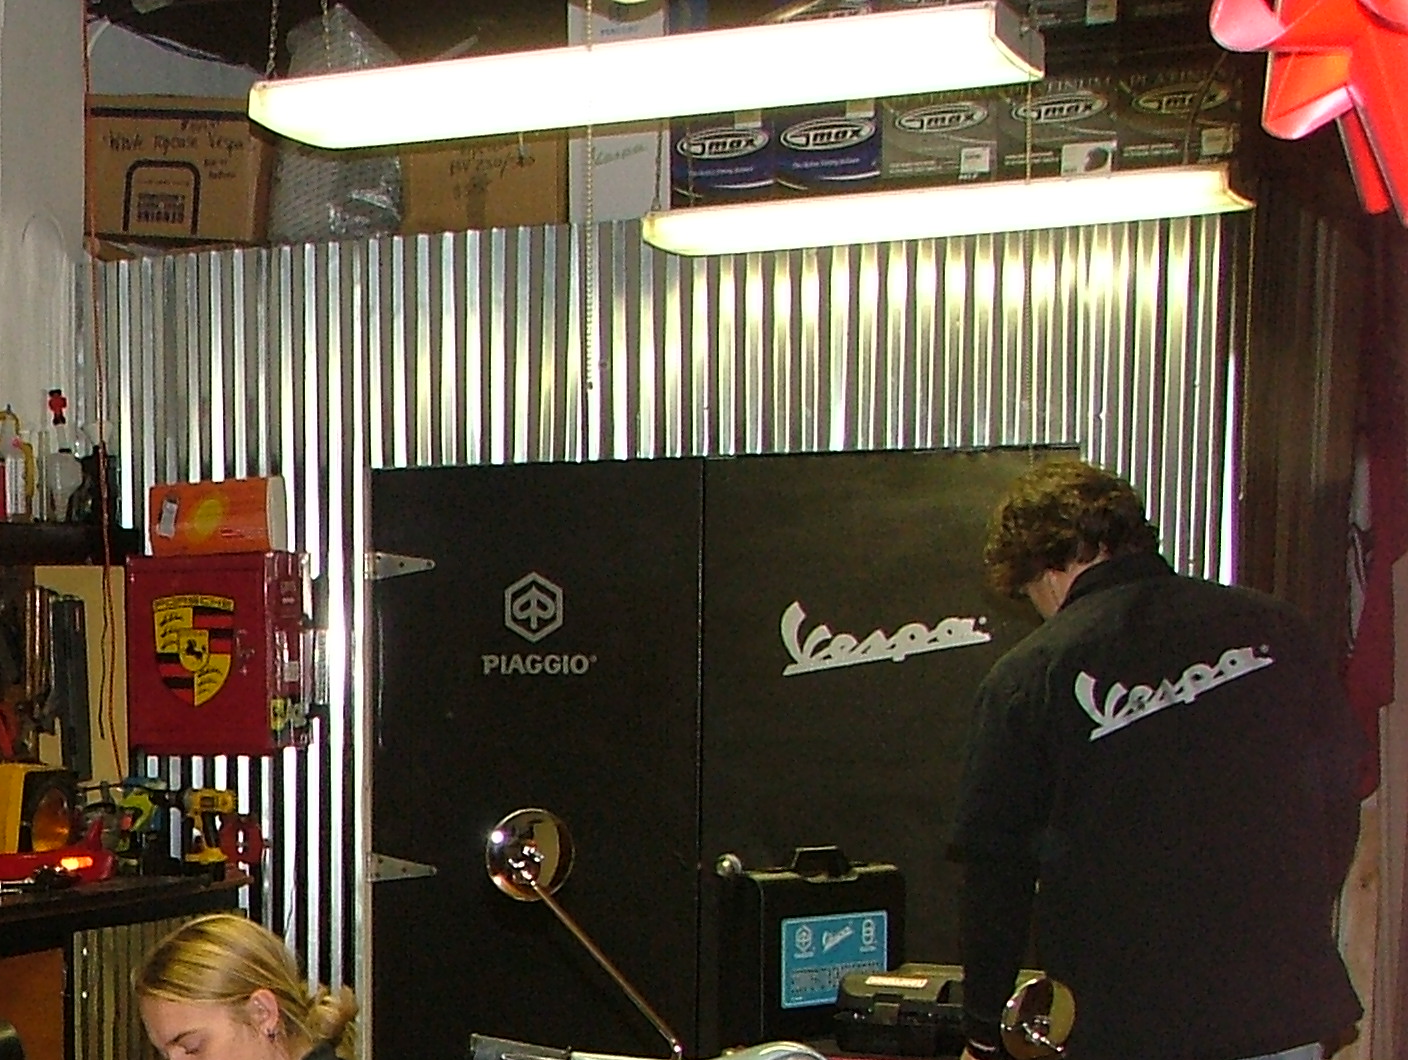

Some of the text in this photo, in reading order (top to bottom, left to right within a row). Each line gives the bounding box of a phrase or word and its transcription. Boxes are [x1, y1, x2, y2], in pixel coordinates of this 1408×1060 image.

[481, 653, 591, 676] PIAGGIO
[781, 600, 991, 677] Vespa
[1074, 646, 1276, 743] Vespa
